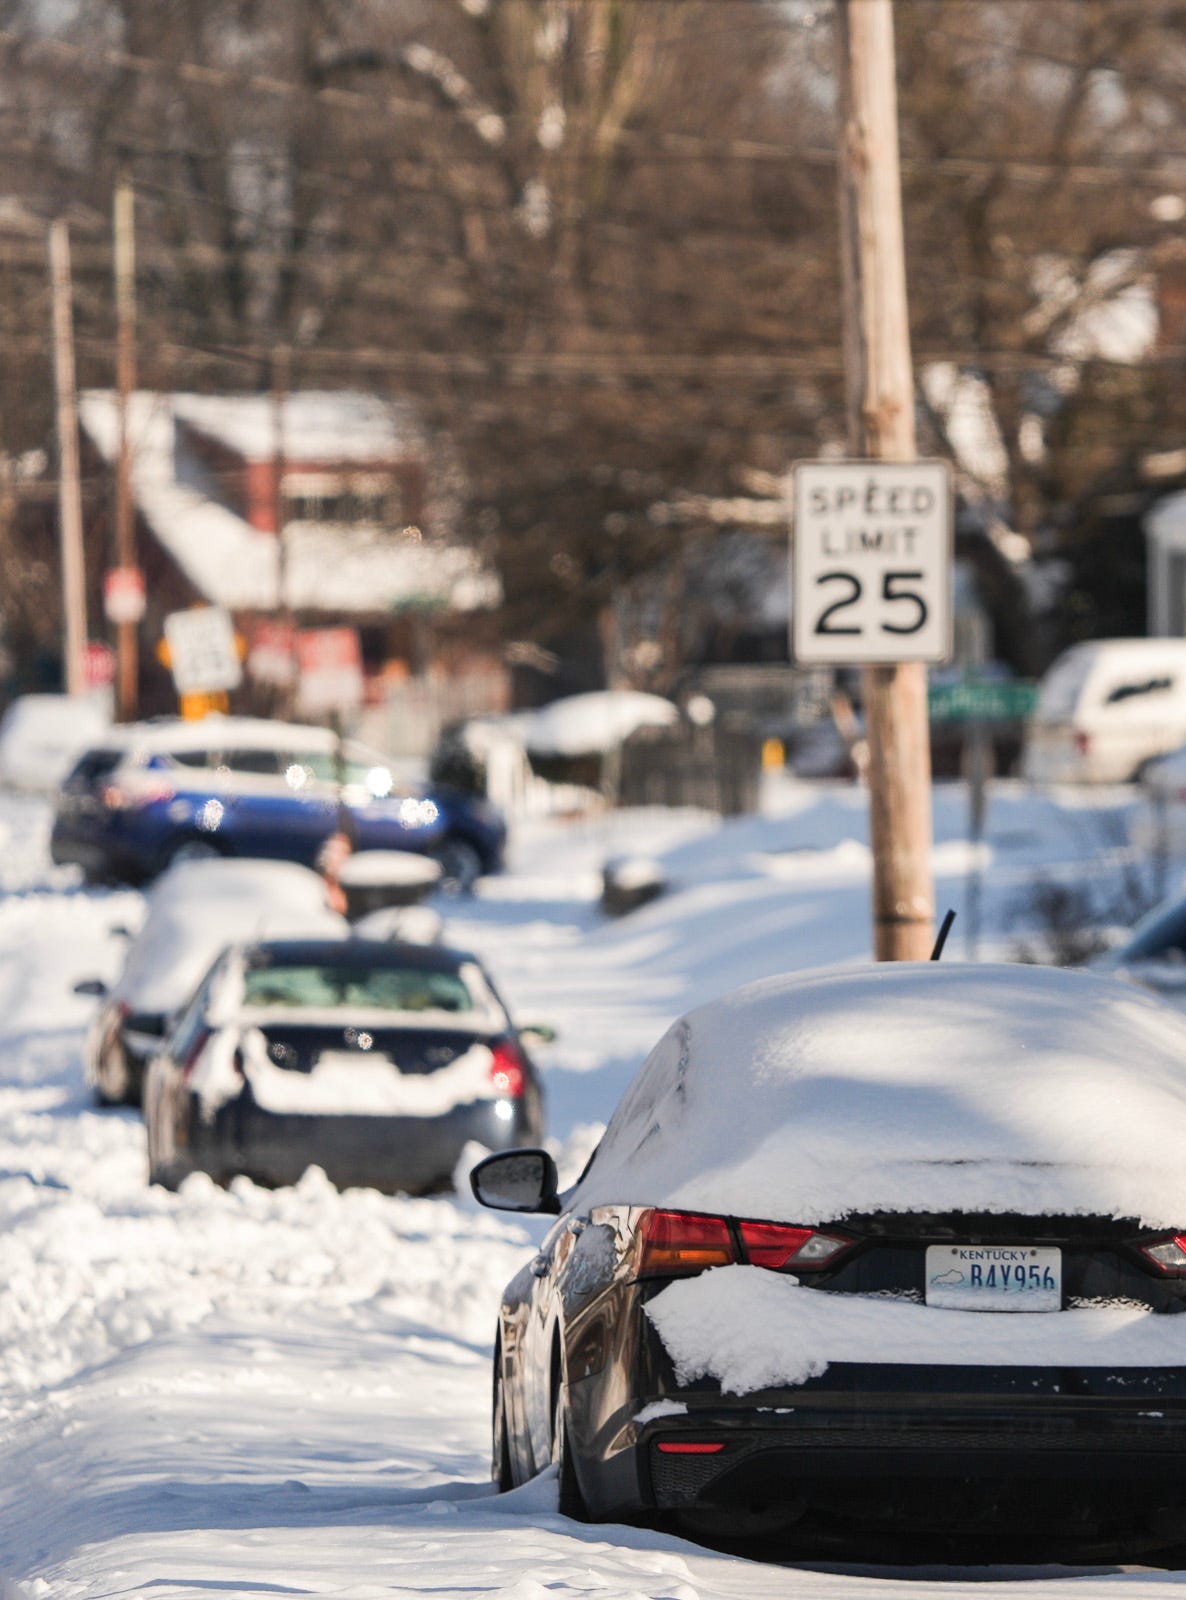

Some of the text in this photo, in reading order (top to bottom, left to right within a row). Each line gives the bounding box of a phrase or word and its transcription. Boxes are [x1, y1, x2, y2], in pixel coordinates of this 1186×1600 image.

[808, 484, 936, 517] SPEED
[821, 526, 918, 557] LIMIT
[814, 571, 928, 635] 25
[959, 1249, 1029, 1261] KENTUCKY
